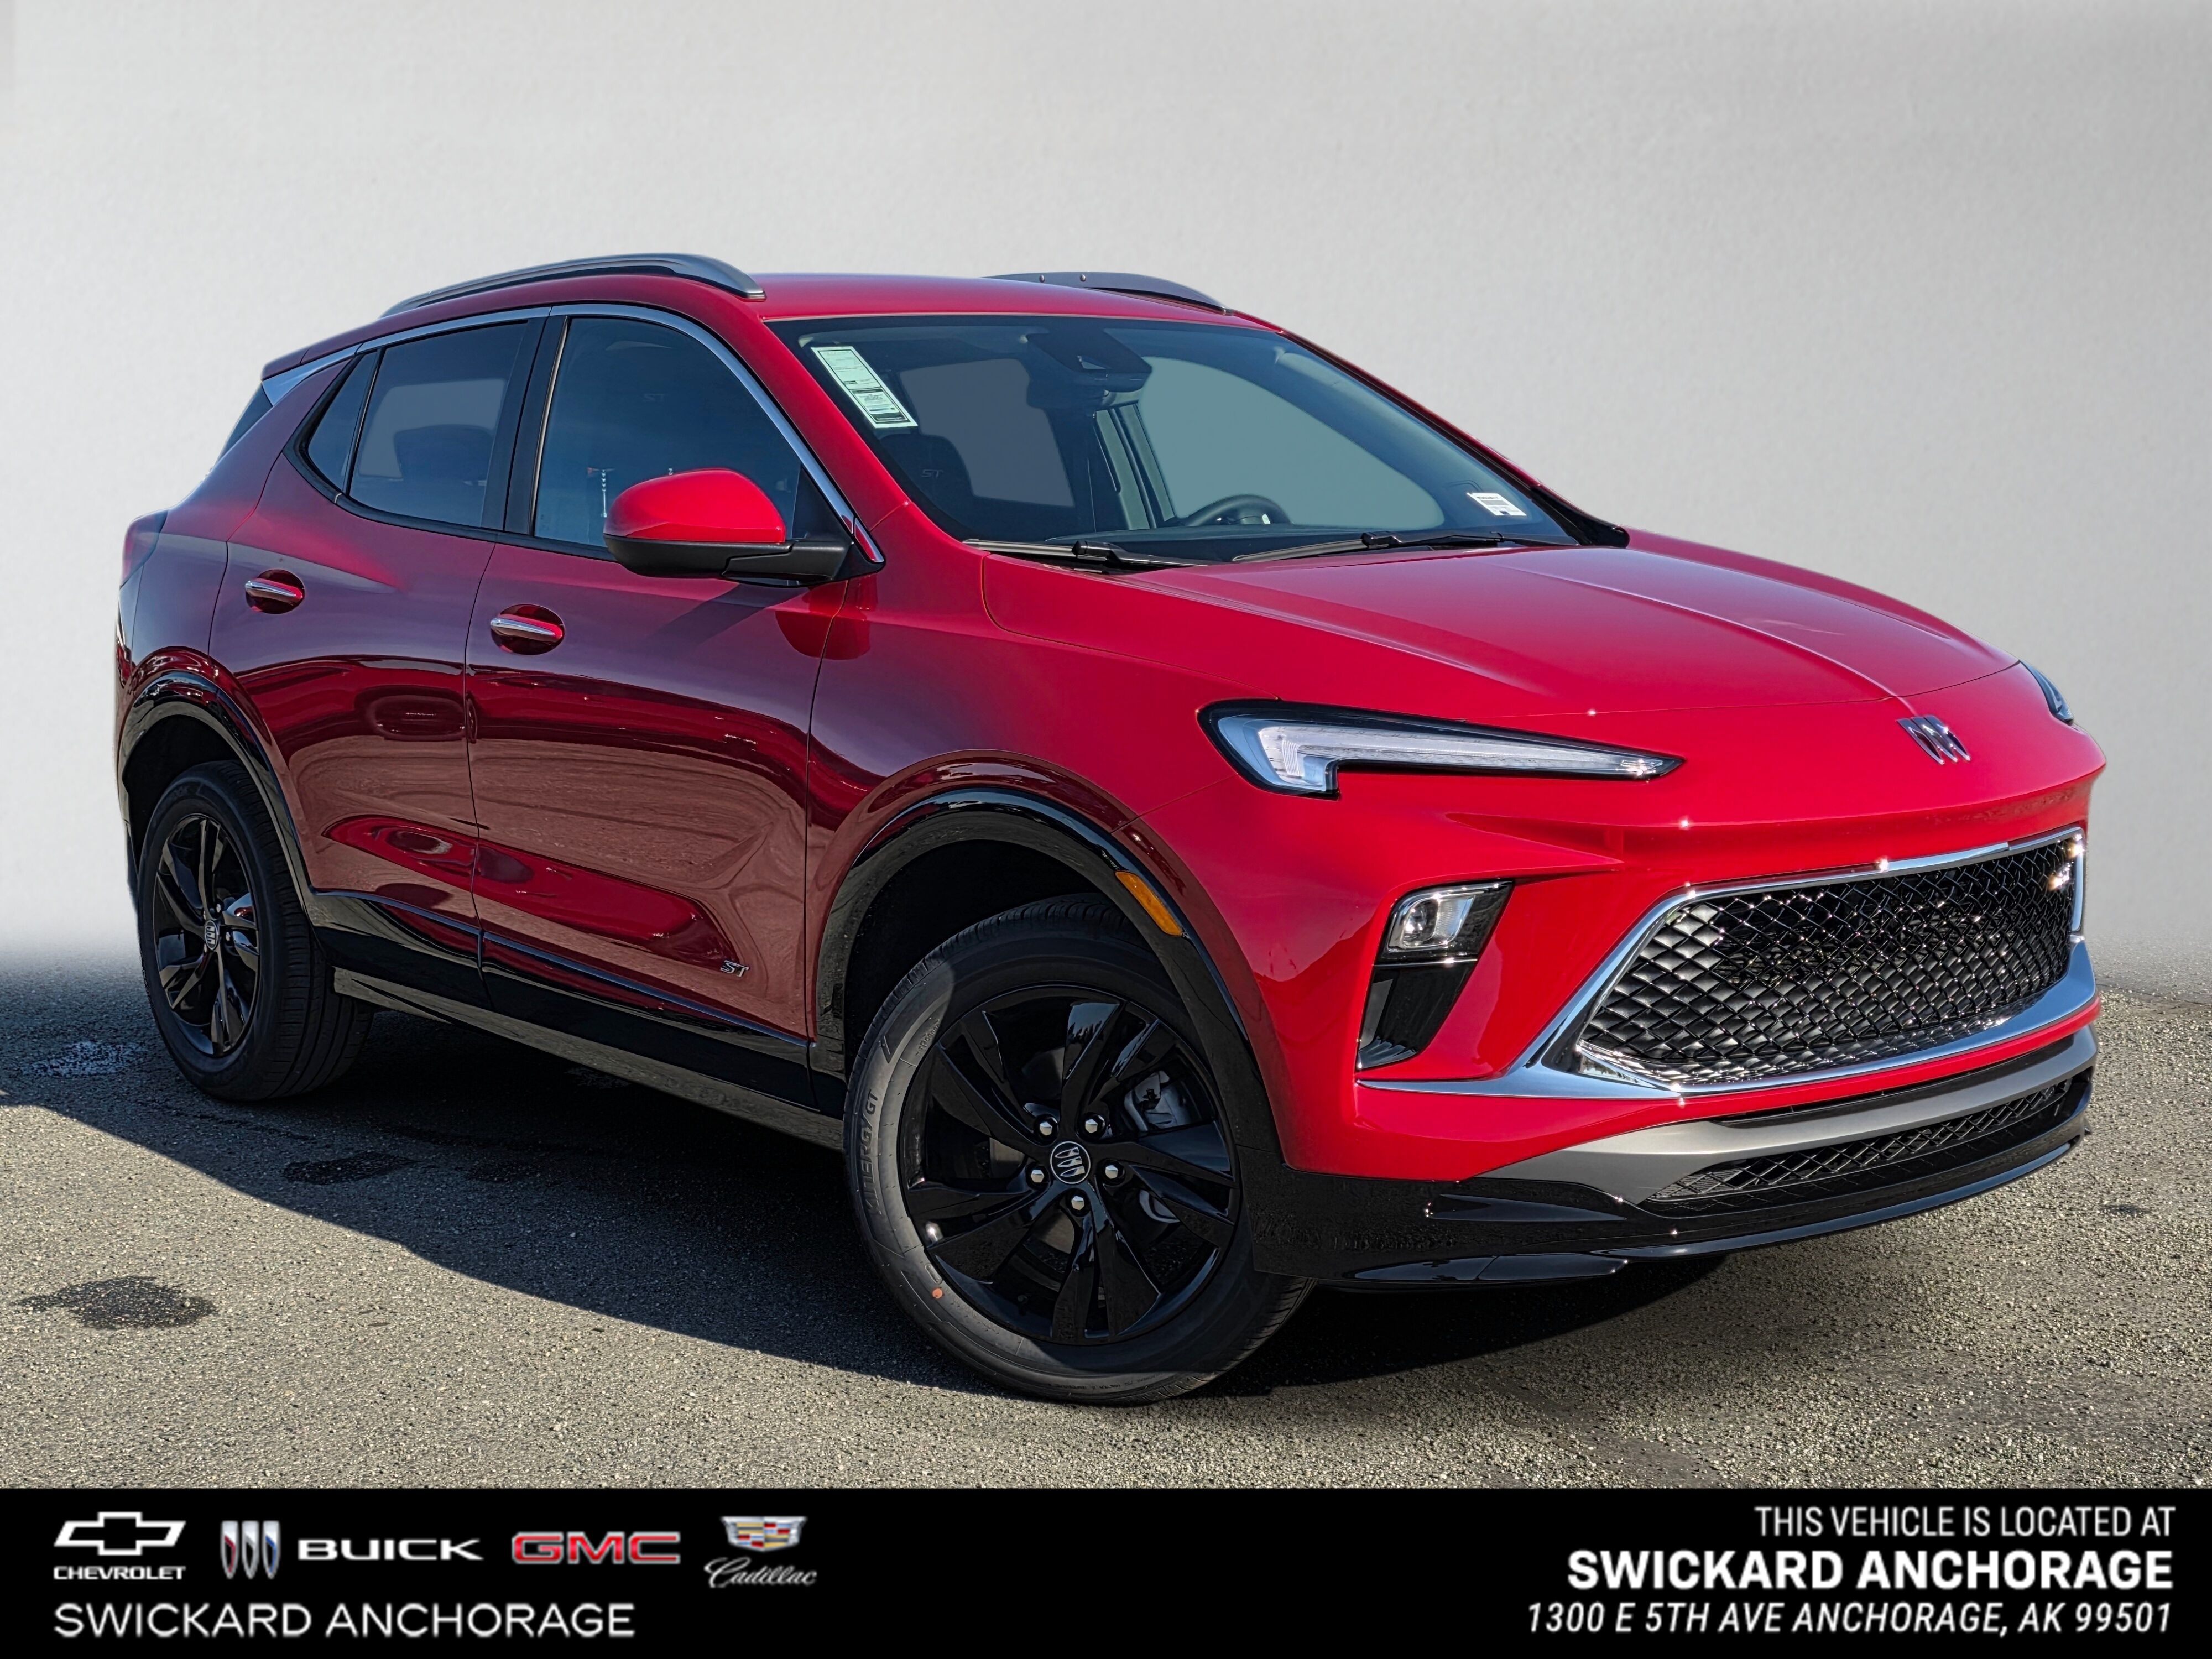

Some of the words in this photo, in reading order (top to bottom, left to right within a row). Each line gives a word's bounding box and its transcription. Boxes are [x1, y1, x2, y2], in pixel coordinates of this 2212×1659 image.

[920, 469, 944, 479] ST
[720, 959, 750, 978] ST
[866, 1089, 878, 1115] GT
